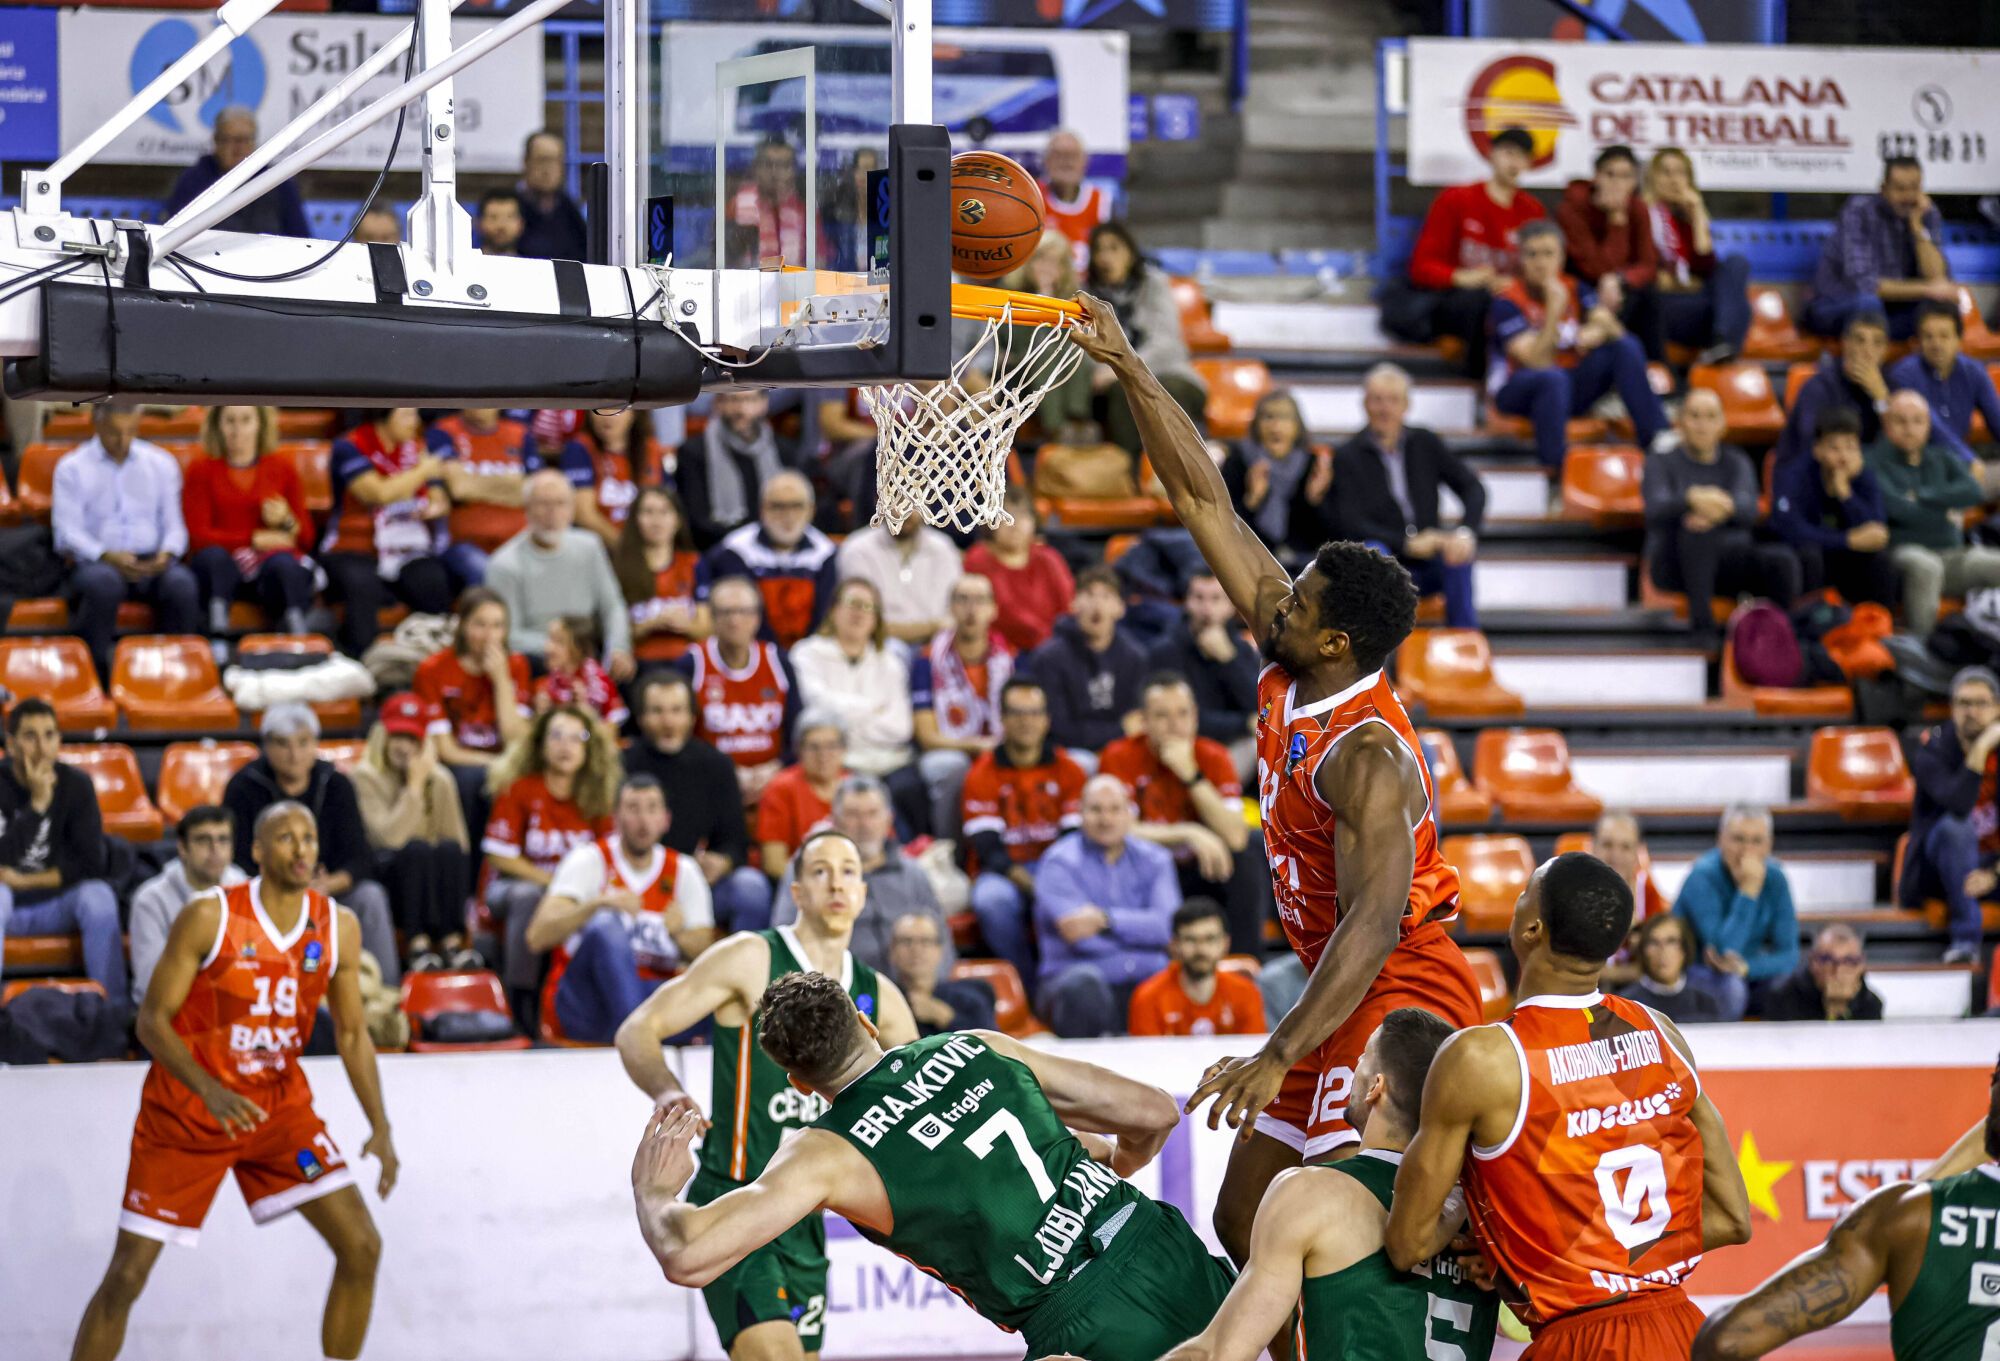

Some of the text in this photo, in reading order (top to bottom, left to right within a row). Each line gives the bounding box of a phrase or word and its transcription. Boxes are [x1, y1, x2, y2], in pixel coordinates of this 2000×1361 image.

[1588, 73, 1848, 110] CATALANA
[1590, 110, 1647, 144] DE
[1660, 112, 1853, 148] TREBALL
[230, 1023, 303, 1053] BAX
[1546, 1029, 1663, 1086] AKOBUNDU-EHIOGU
[849, 1034, 987, 1149] BRAJKOVIĆ
[941, 1078, 996, 1123] triglav
[962, 1107, 1057, 1204] 7
[1593, 1143, 1672, 1250] 0
[1803, 1159, 1943, 1220] EST
[1939, 1205, 2000, 1249] ST
[797, 1294, 827, 1337] 2
